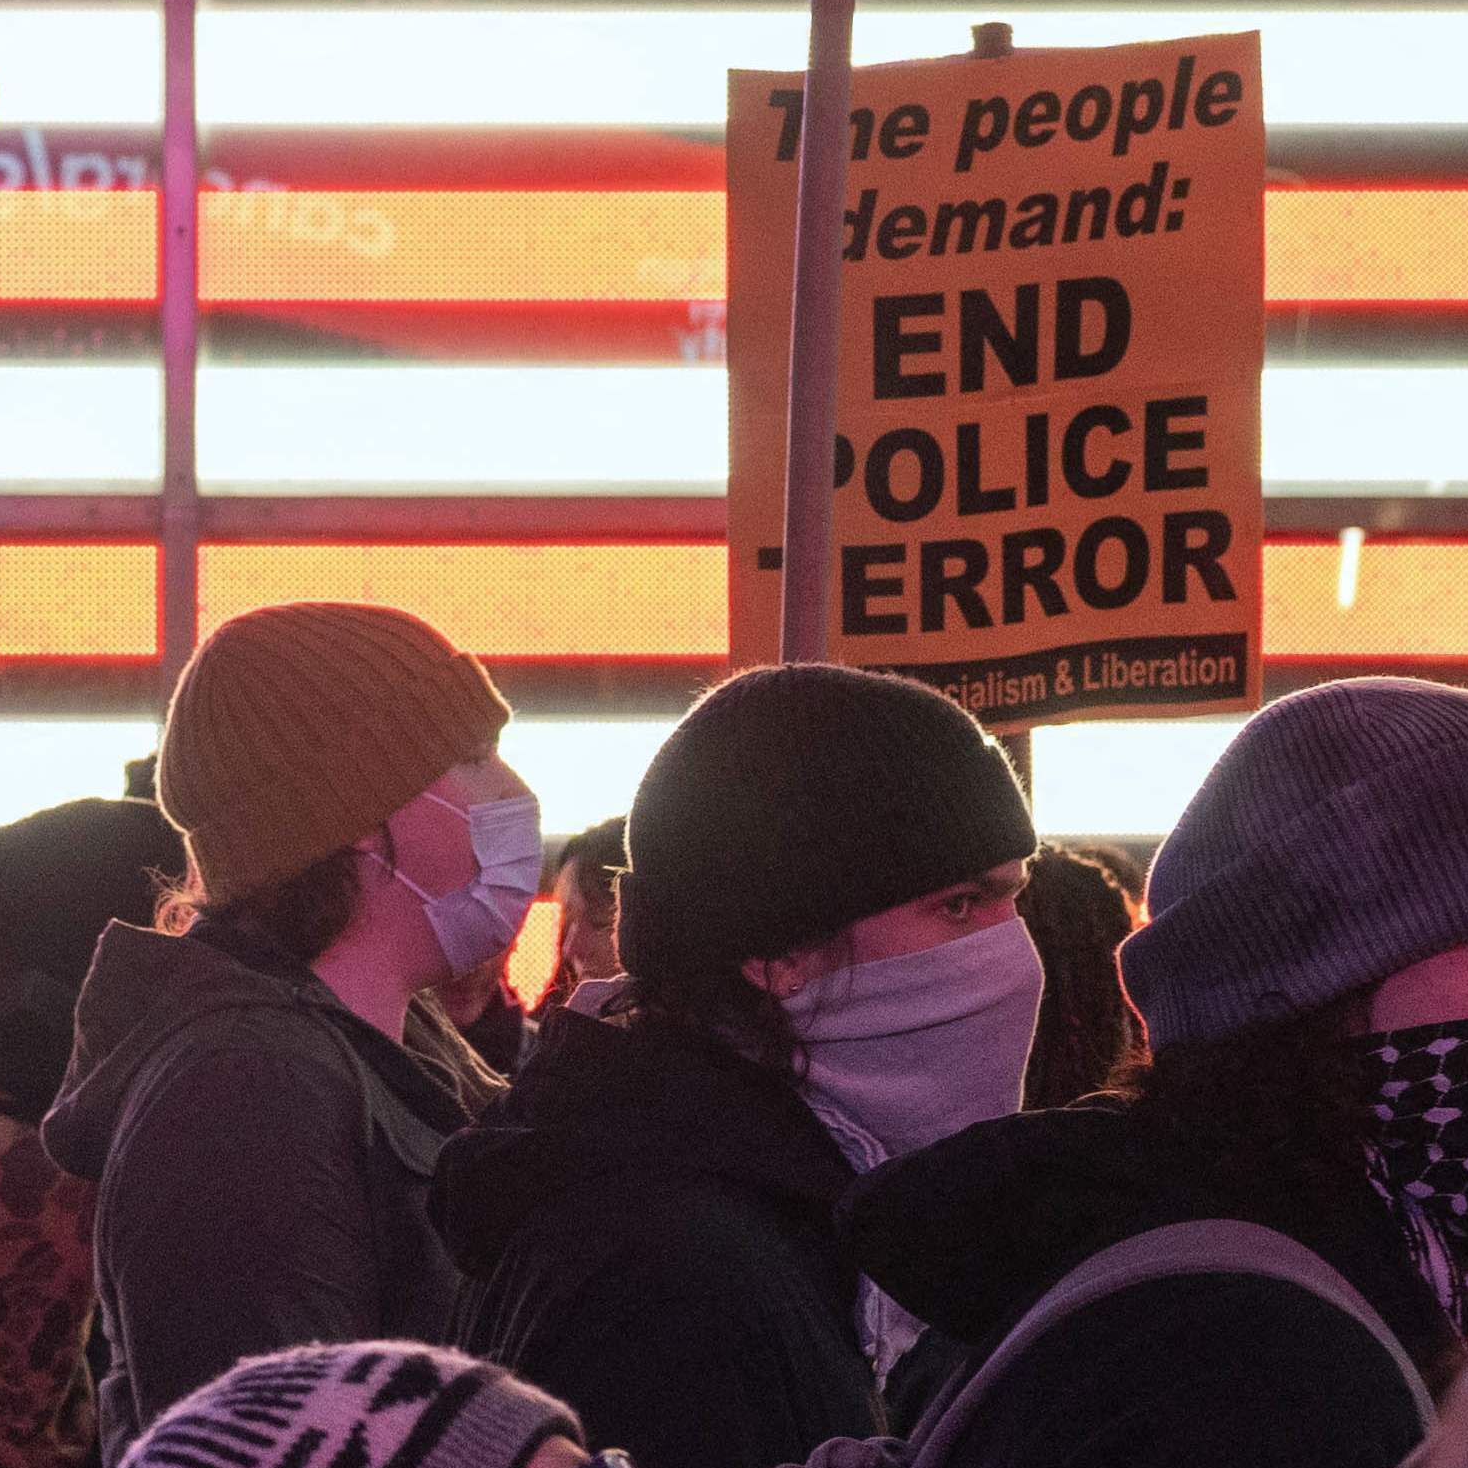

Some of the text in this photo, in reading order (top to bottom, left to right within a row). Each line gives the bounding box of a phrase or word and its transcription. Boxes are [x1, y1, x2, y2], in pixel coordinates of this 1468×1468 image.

[954, 54, 1244, 173] people
[872, 275, 1133, 401] END
[757, 508, 1238, 637] ERROR
[1054, 658, 1076, 696] &
[1082, 647, 1237, 691] Liberation
